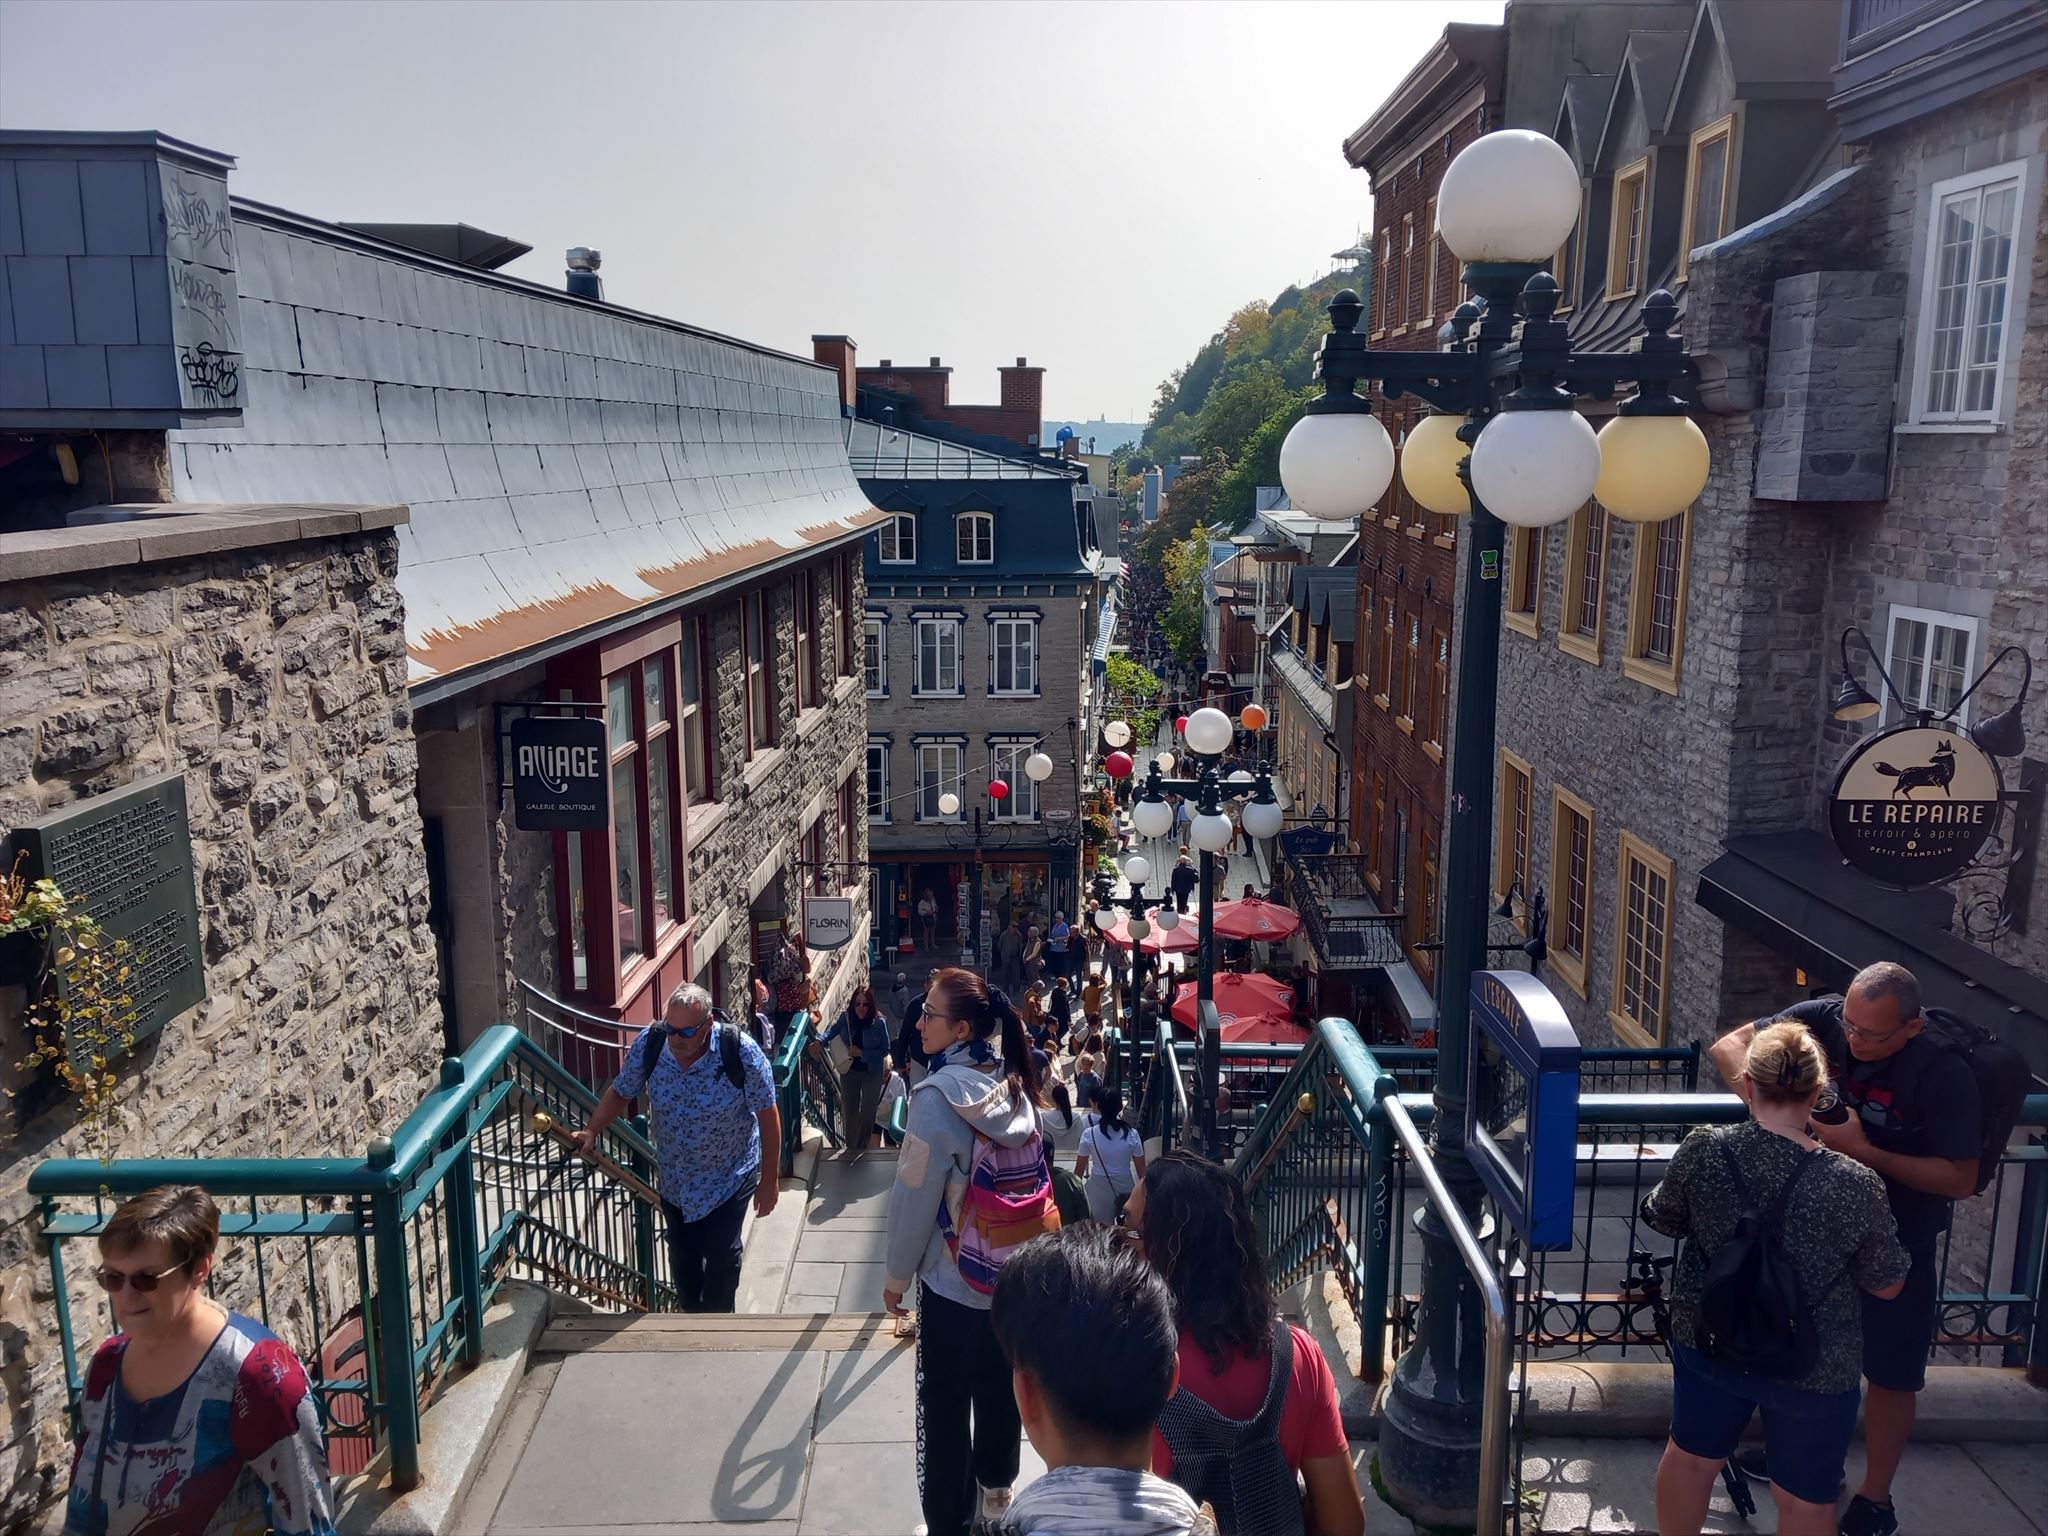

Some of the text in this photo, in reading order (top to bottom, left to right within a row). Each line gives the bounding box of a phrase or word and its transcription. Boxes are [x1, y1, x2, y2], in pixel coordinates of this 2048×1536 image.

[526, 803, 597, 811] GALERIE BOUTIQUE
[1848, 804, 1985, 824] LE REPAIRE
[1857, 828, 1970, 840] terroir & apéro
[1869, 846, 1953, 857] PETIT CHAMPLAIN
[810, 918, 848, 928] FLORIN
[1483, 979, 1522, 1038] L'ESCALE
